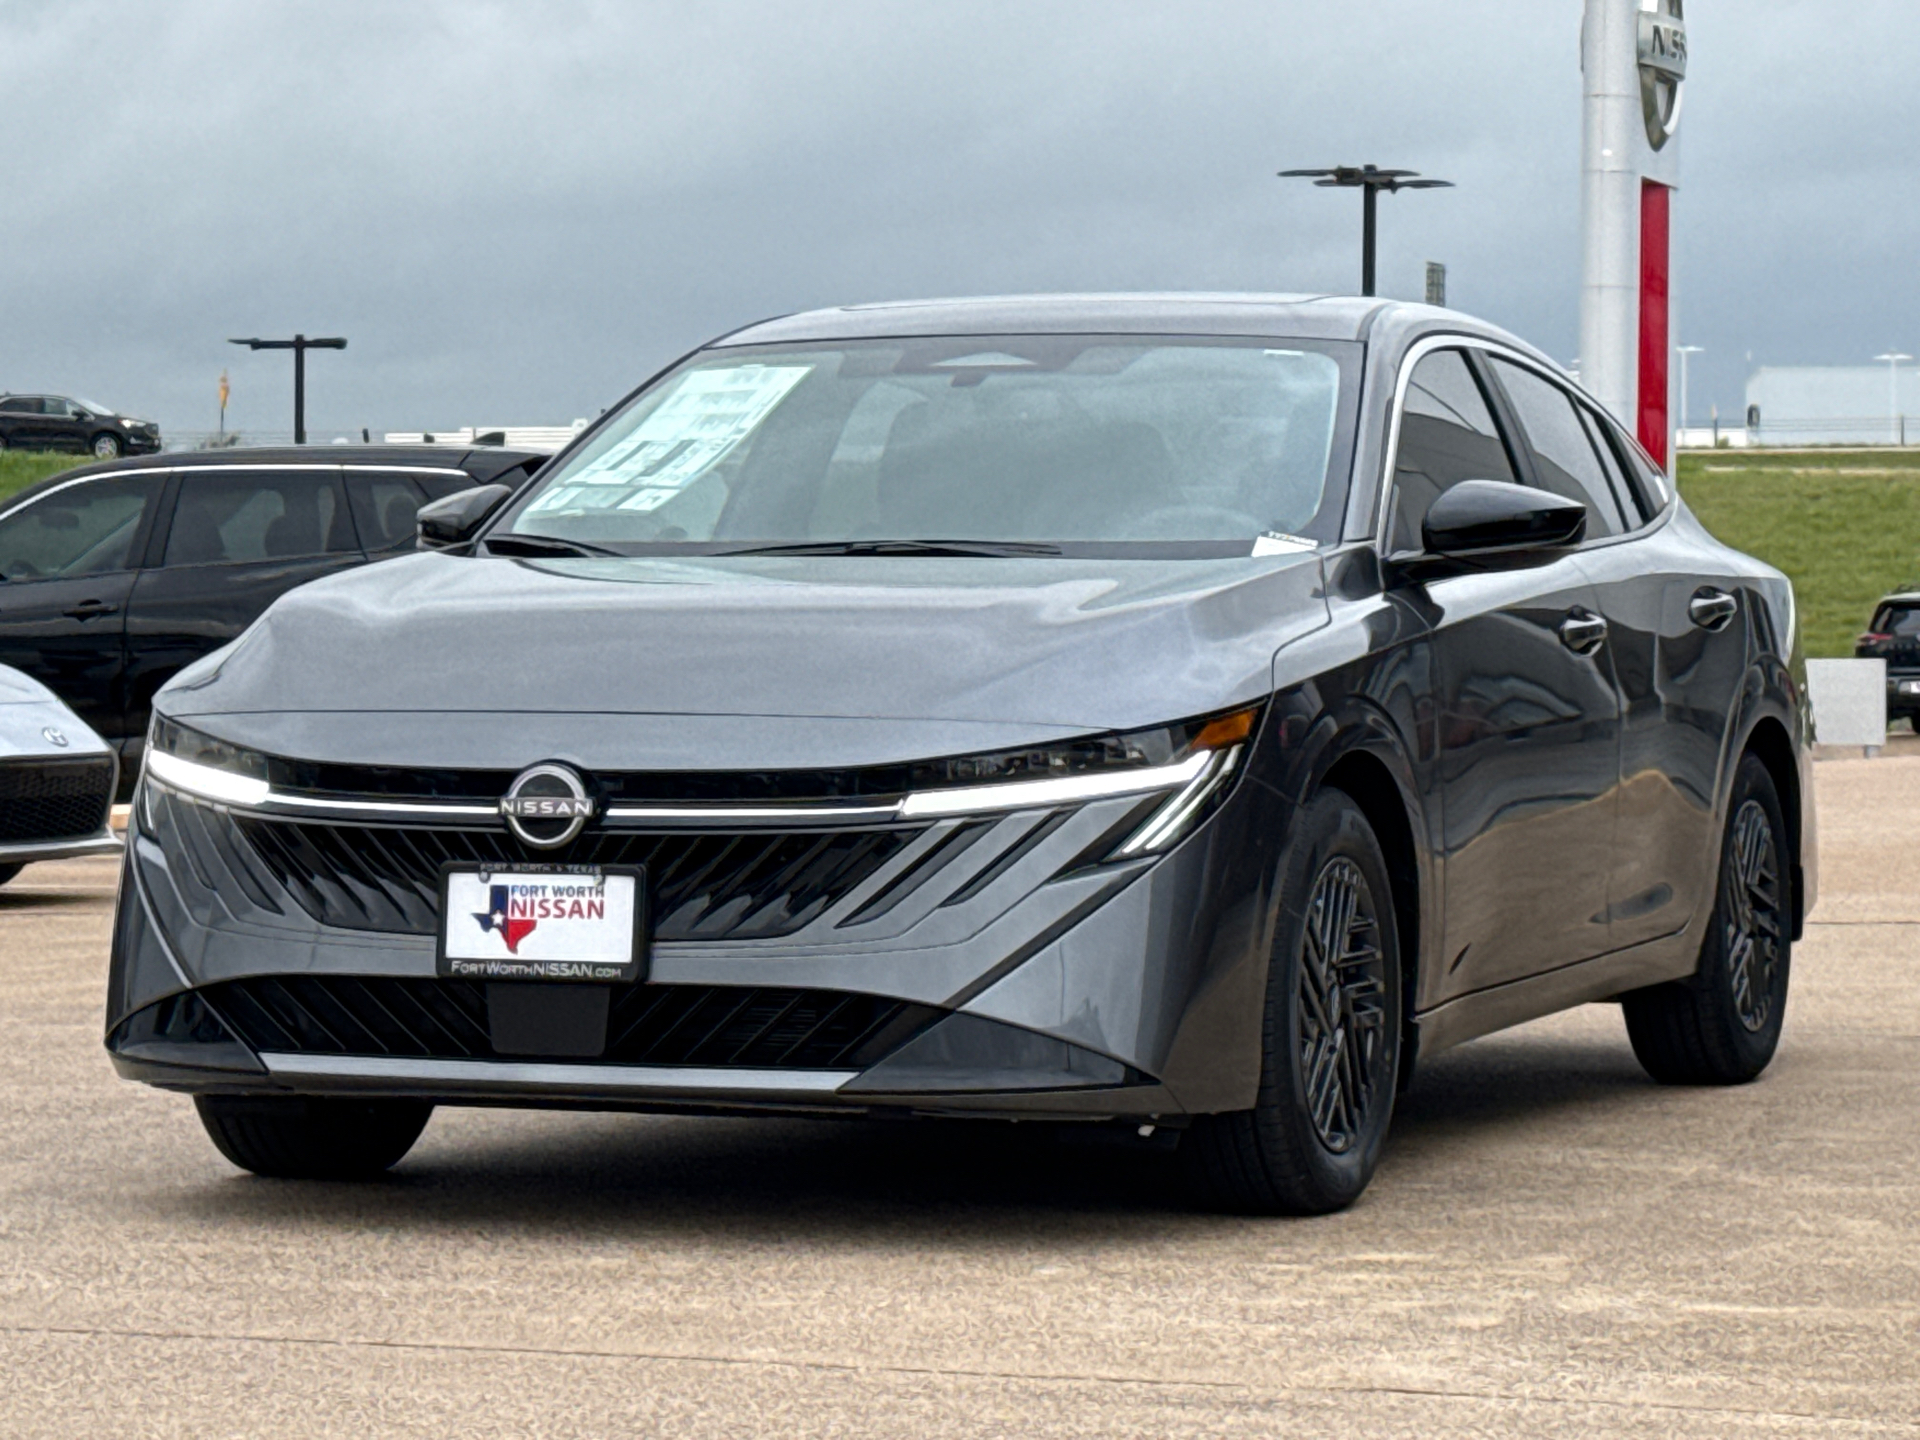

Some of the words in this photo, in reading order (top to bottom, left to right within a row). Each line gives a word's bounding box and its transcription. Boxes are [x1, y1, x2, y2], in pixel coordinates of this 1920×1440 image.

[501, 800, 591, 815] NISSAN
[567, 864, 601, 874] TEXAS
[510, 885, 548, 897] FORT
[552, 885, 605, 898] WORTH
[510, 898, 604, 920] NISSAN
